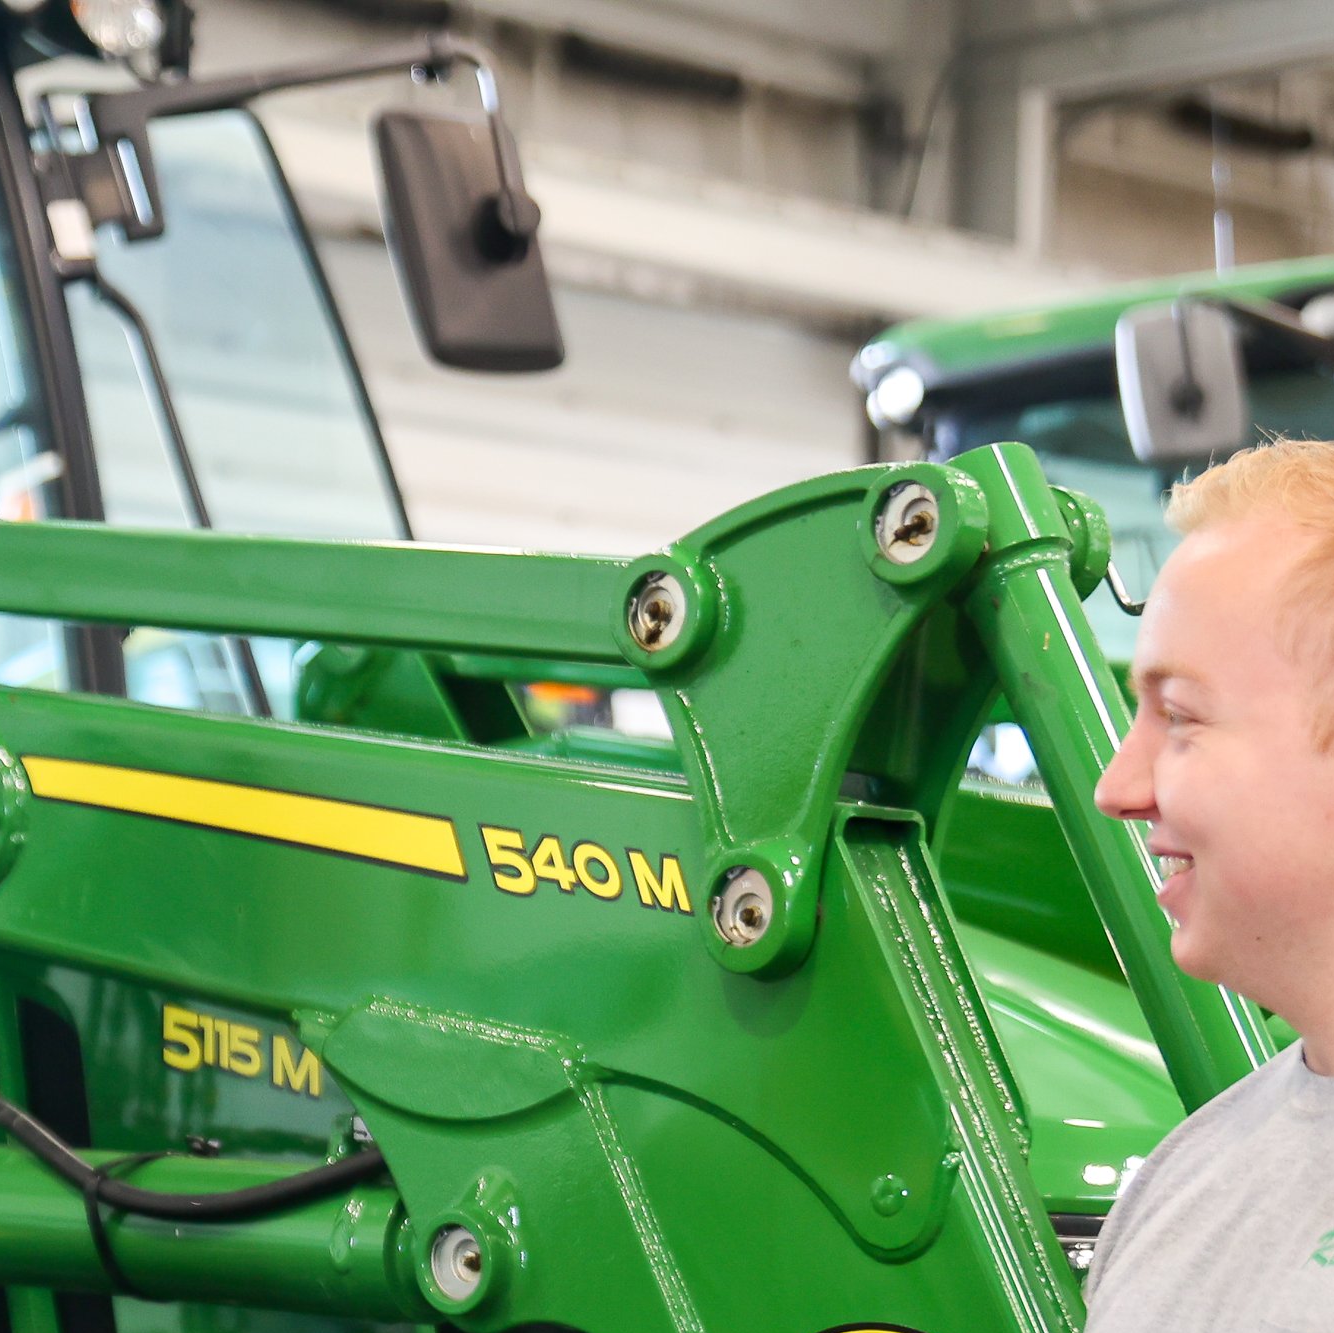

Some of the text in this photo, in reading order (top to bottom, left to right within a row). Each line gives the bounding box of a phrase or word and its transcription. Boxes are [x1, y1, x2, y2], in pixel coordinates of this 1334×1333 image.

[479, 824, 695, 915] 540 M
[162, 1004, 323, 1097] 5115 M
